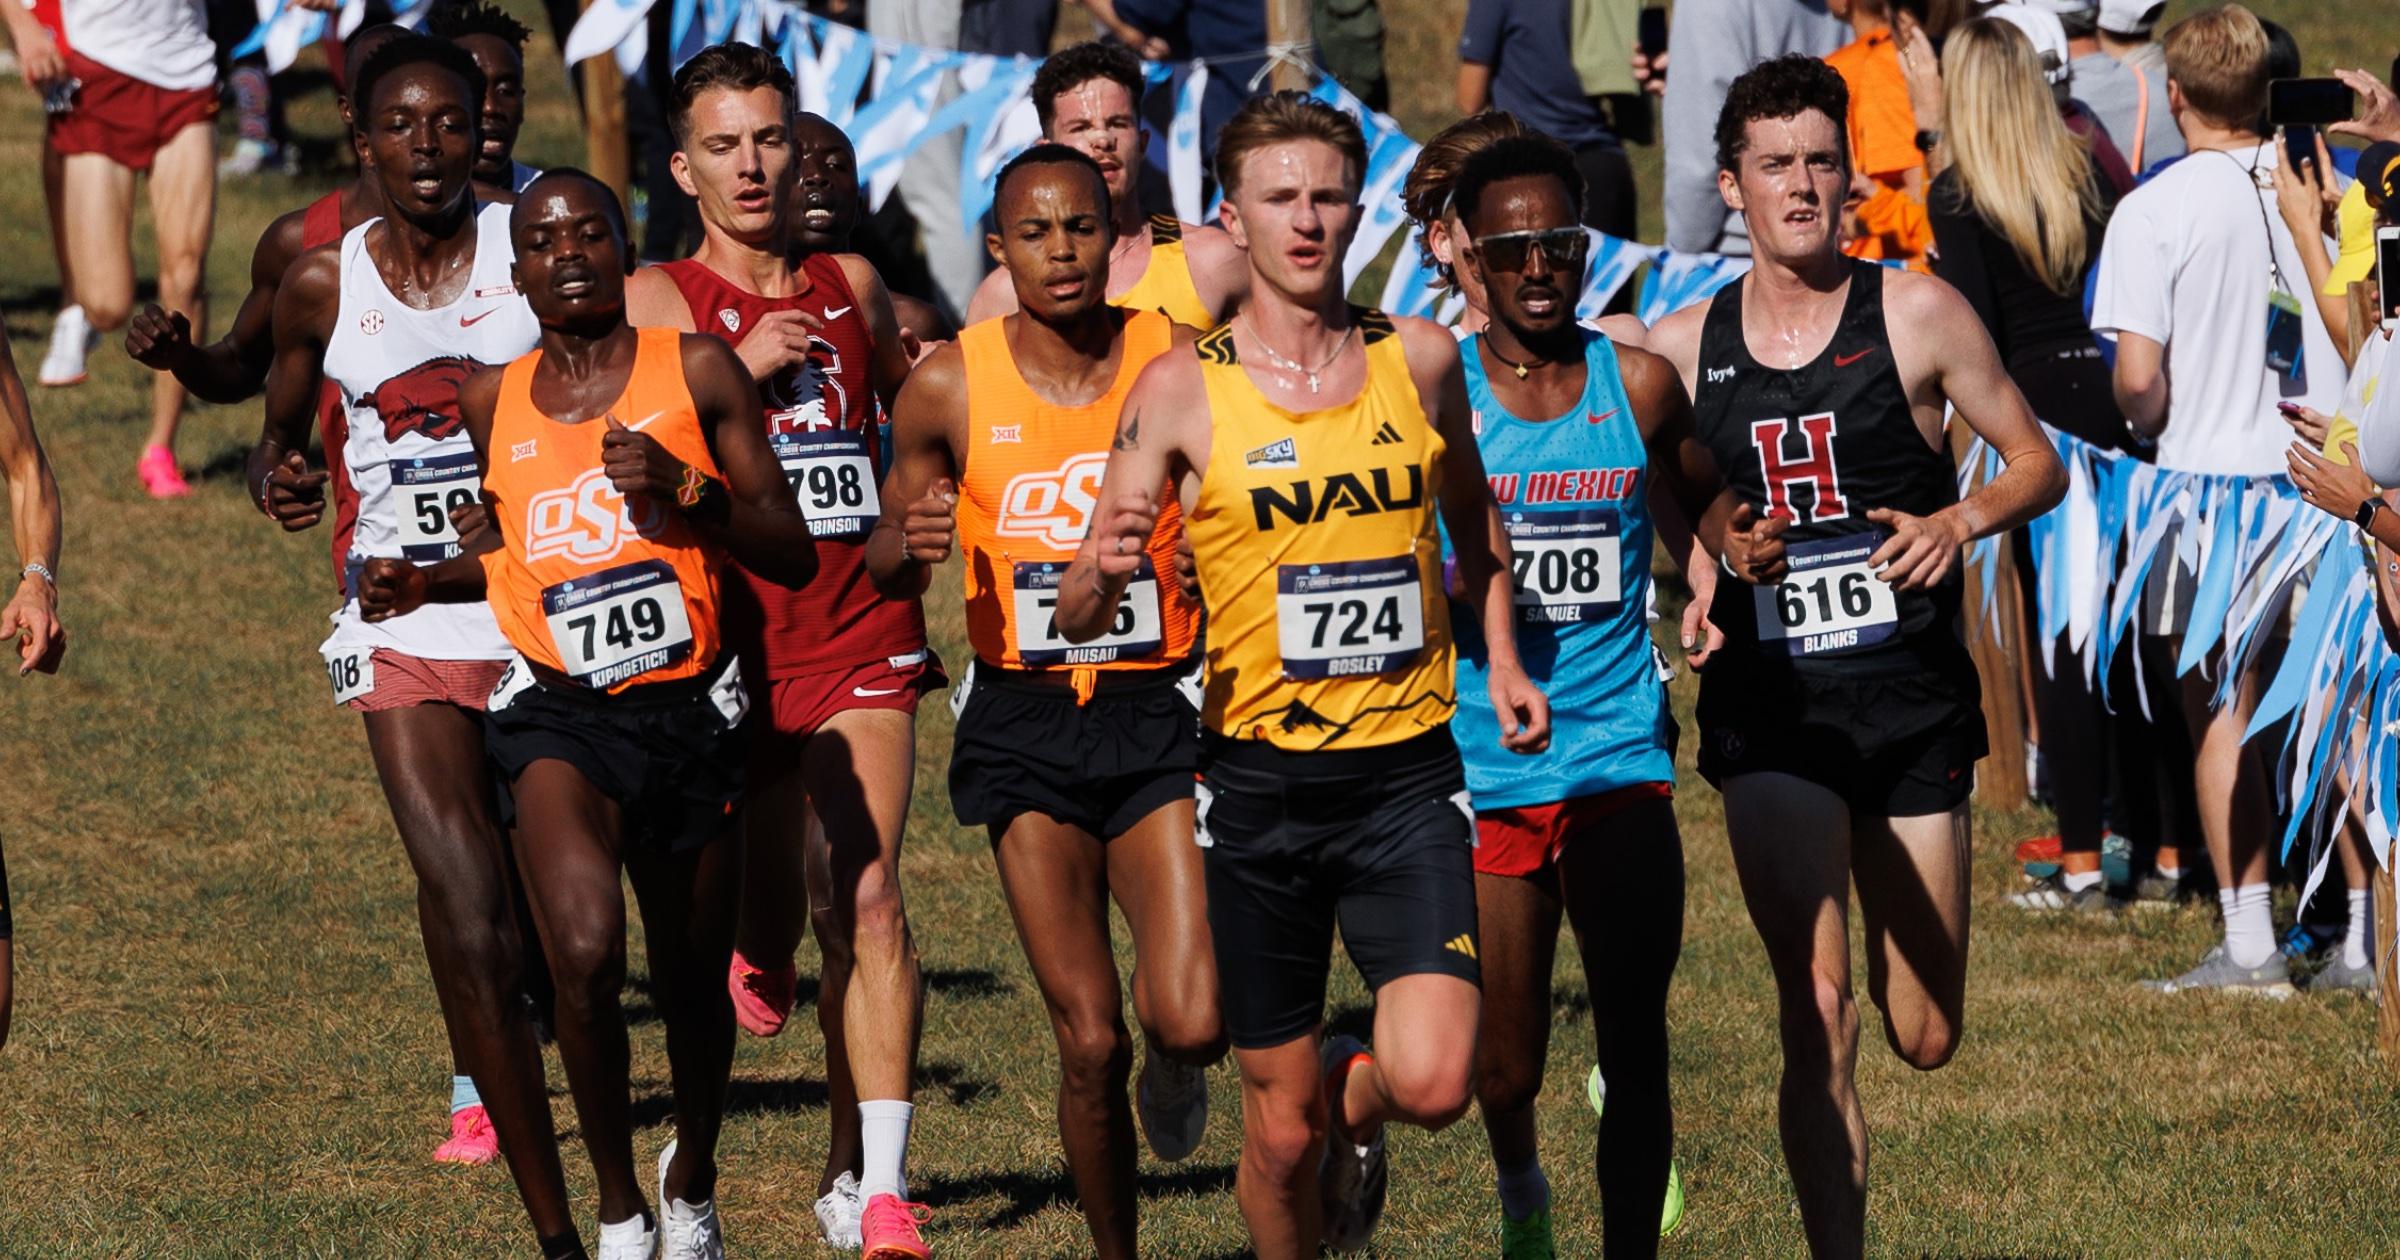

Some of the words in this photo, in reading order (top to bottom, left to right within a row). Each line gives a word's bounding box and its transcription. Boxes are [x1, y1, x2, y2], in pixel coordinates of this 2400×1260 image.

[361, 310, 384, 335] SEC
[784, 464, 863, 509] 798
[1524, 467, 1640, 505] MEXICO
[1751, 411, 1849, 526] H
[996, 452, 1110, 550] OS
[1247, 464, 1423, 532] NAU
[806, 517, 861, 536] OBINSON
[1513, 547, 1600, 595] 708
[1525, 605, 1582, 622] SAMUEL
[1775, 572, 1872, 628] 616
[566, 597, 666, 663] 749
[1304, 596, 1403, 649] 724
[1803, 629, 1858, 653] BLANKS
[327, 654, 360, 694] 08
[590, 649, 669, 689] KIPNGETICH
[1065, 647, 1118, 664] MUSAU
[1327, 655, 1386, 676] BOSLEY
